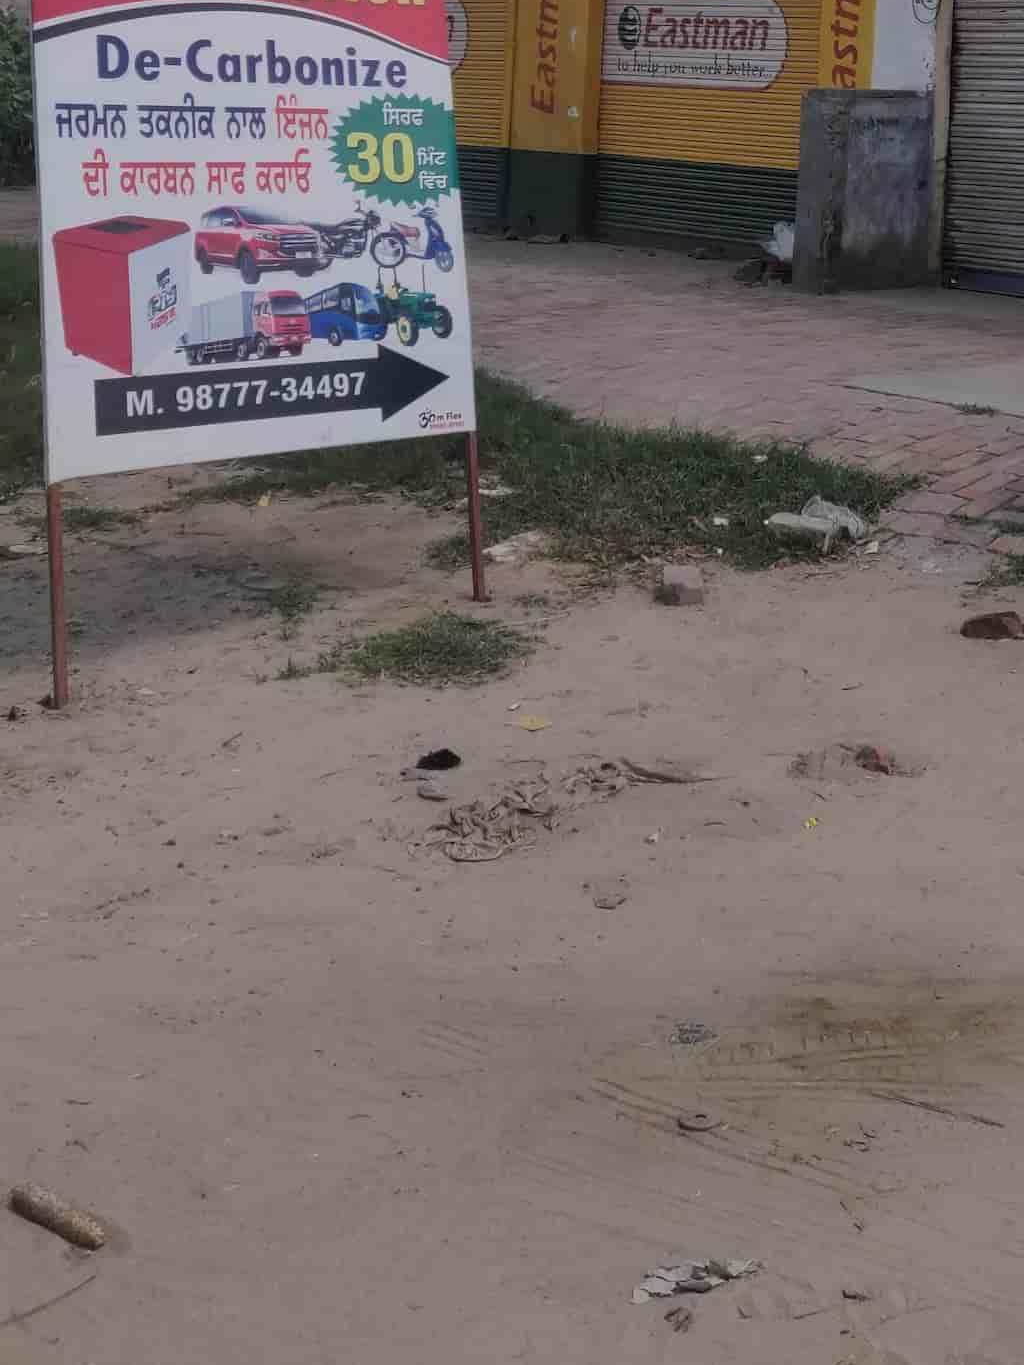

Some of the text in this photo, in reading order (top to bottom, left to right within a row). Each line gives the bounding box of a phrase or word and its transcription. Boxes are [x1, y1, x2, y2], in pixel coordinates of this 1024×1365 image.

[642, 7, 769, 50] Eastman
[96, 34, 407, 87] De-Carbonize
[617, 57, 629, 72] to
[633, 50, 659, 77] help
[690, 53, 721, 75] work
[55, 102, 127, 139] ਜਰਮਨ
[138, 92, 215, 140] ਤਕਨੀਕ
[225, 106, 266, 140] ਨਾਲ
[382, 102, 424, 125] ਸਿਰਫ
[82, 148, 312, 196] ਦੀ ਕਾਰਬਨ ਸਾਫ ਕਰਾਓ
[347, 132, 415, 184] 30
[416, 146, 447, 166] ਮਿੰਟ
[126, 371, 366, 418] M. 98777-34497
